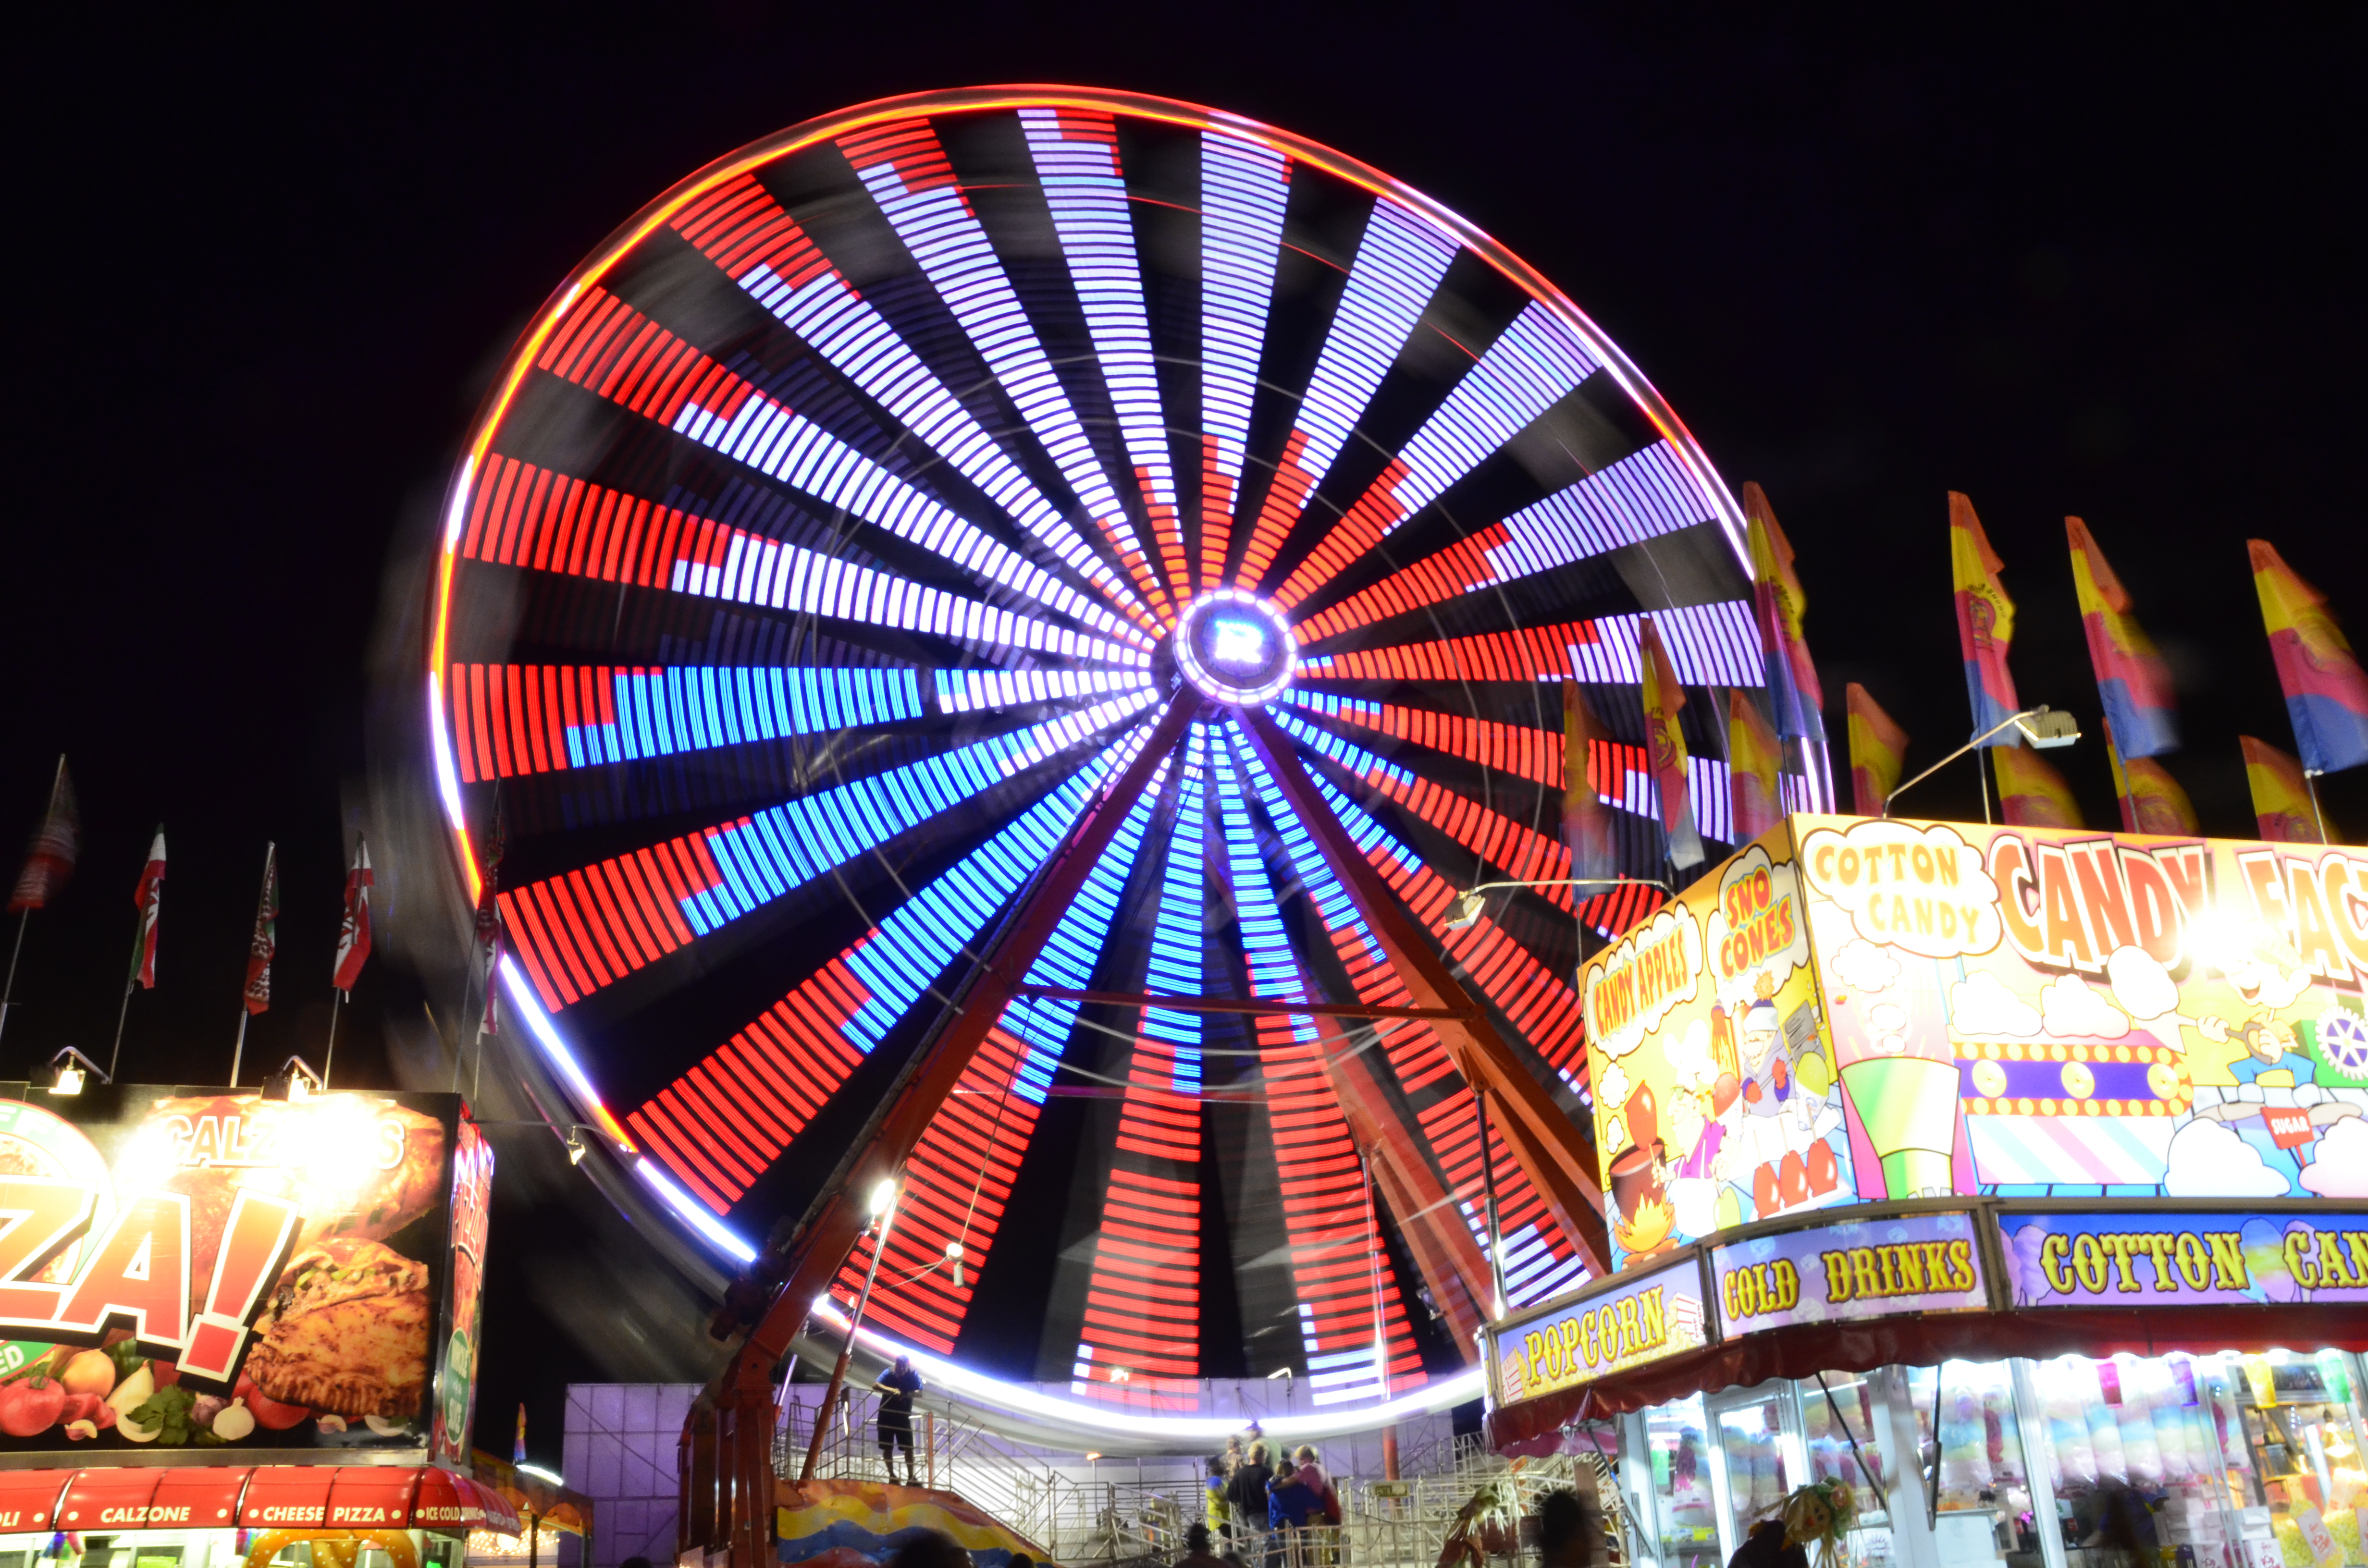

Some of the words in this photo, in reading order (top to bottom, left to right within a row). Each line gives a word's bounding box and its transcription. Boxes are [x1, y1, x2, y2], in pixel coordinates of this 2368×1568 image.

[1814, 843, 1961, 886] COTTON
[1726, 865, 1772, 928] SNO
[1868, 892, 1981, 944] CANDY
[2237, 850, 2368, 981] FAC
[1719, 896, 1796, 979] CONES
[1592, 960, 1636, 1039] CANDY
[1633, 920, 1689, 1014] APPLES
[2271, 1115, 2311, 1135] SUGAR
[1723, 1258, 1800, 1321] COLD
[1823, 1237, 1977, 1304] DRINKS
[2040, 1231, 2250, 1294] COTTON
[1524, 1284, 1666, 1386] POPCORN
[100, 1507, 191, 1523] CALZONE
[263, 1507, 324, 1522] CHEESE
[333, 1507, 385, 1522] PIZZA
[426, 1507, 438, 1520] ICE
[439, 1507, 460, 1520] COLD
